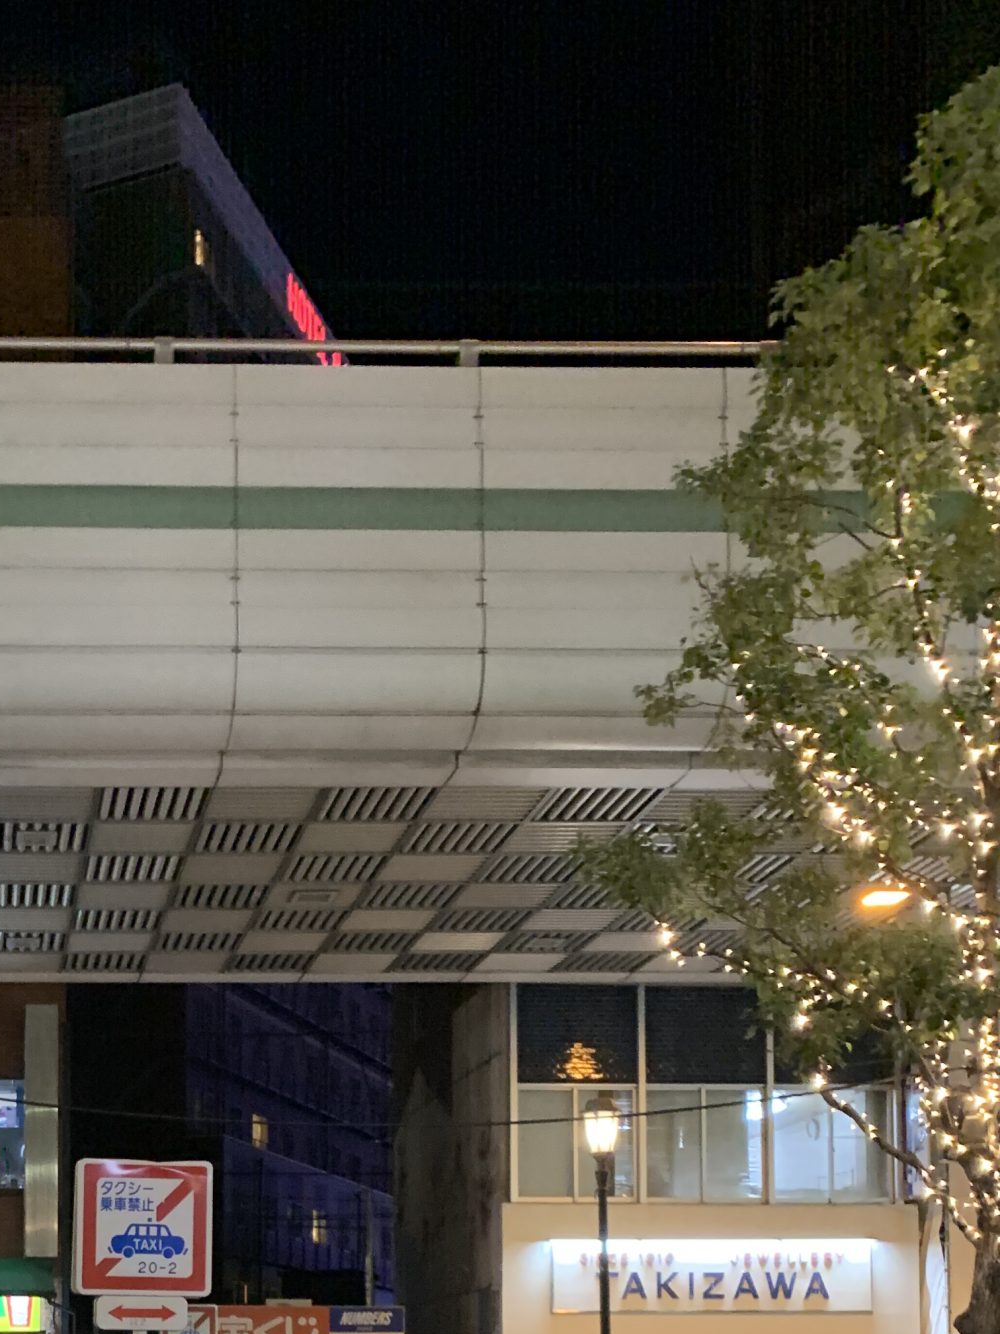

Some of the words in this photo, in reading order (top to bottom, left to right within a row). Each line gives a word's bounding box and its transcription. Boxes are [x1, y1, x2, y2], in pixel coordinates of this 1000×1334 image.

[101, 1181, 154, 1196] タクシー
[101, 1197, 155, 1212] 乗車禁止
[133, 1238, 162, 1251] TAXI
[138, 1262, 177, 1275] 20-2
